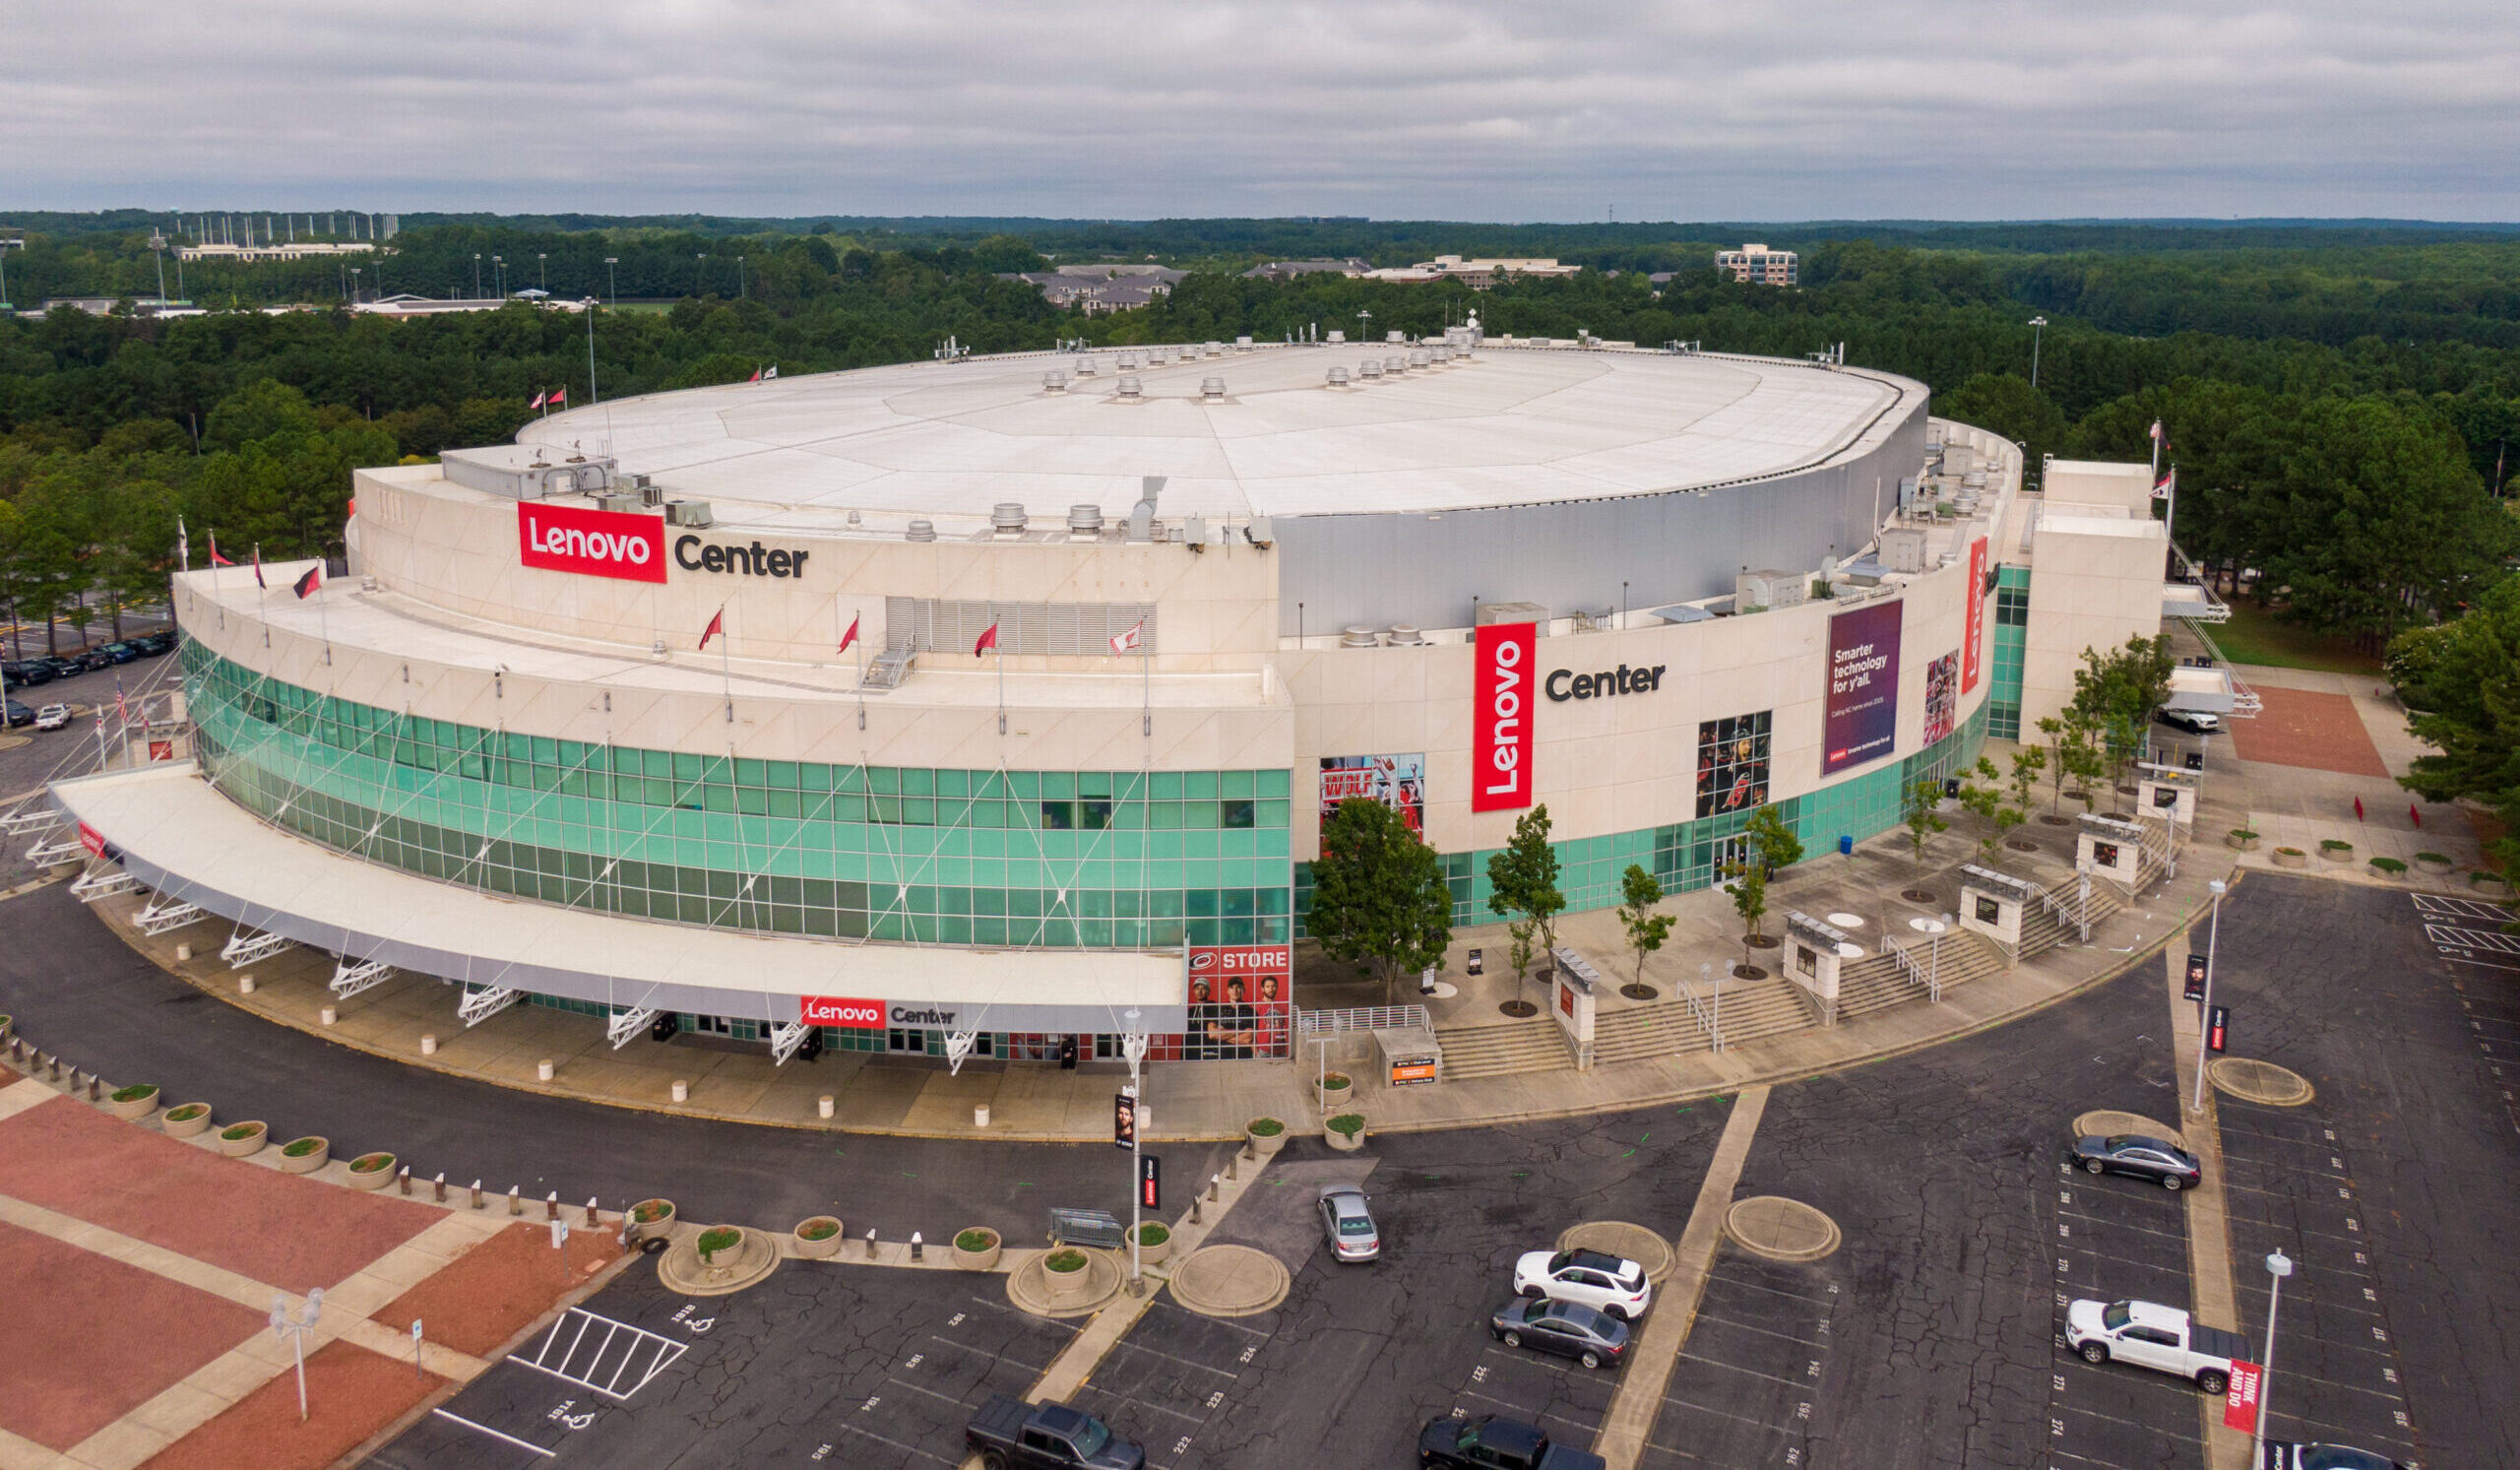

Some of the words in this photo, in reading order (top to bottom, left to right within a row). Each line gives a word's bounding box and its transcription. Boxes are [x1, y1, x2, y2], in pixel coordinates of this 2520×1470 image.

[530, 517, 651, 565] Lenovo
[674, 534, 809, 578] Center
[1969, 552, 1984, 677] Lenovo
[1835, 644, 1874, 664] Smarter
[1834, 655, 1887, 679] technology
[1833, 679, 1848, 694] for
[1486, 640, 1521, 795] Lenovo
[1545, 664, 1666, 702] Center
[1325, 772, 1372, 797] WOLF
[1223, 952, 1287, 969] STORE
[807, 1002, 878, 1022] Lenovo
[891, 1006, 955, 1025] Center
[2057, 1258, 2068, 1272] 270
[2056, 1294, 2067, 1307] 271
[670, 1304, 696, 1322] 191B
[947, 1310, 968, 1327] 192
[2055, 1334, 2066, 1349] 272
[2371, 1326, 2387, 1341] 317
[905, 1352, 924, 1370] 193
[1239, 1346, 1257, 1364] 224
[2053, 1374, 2065, 1391] 273
[2230, 1367, 2244, 1392] AND
[2382, 1368, 2397, 1383] 316
[2242, 1372, 2258, 1405] THINK
[861, 1394, 882, 1412] 194
[1207, 1390, 1225, 1409] 223
[2229, 1393, 2241, 1408] DO
[547, 1400, 576, 1420] 191A
[2393, 1410, 2409, 1427] 315
[2051, 1419, 2064, 1436] 274
[811, 1442, 834, 1460] 195
[1172, 1436, 1192, 1455] 222
